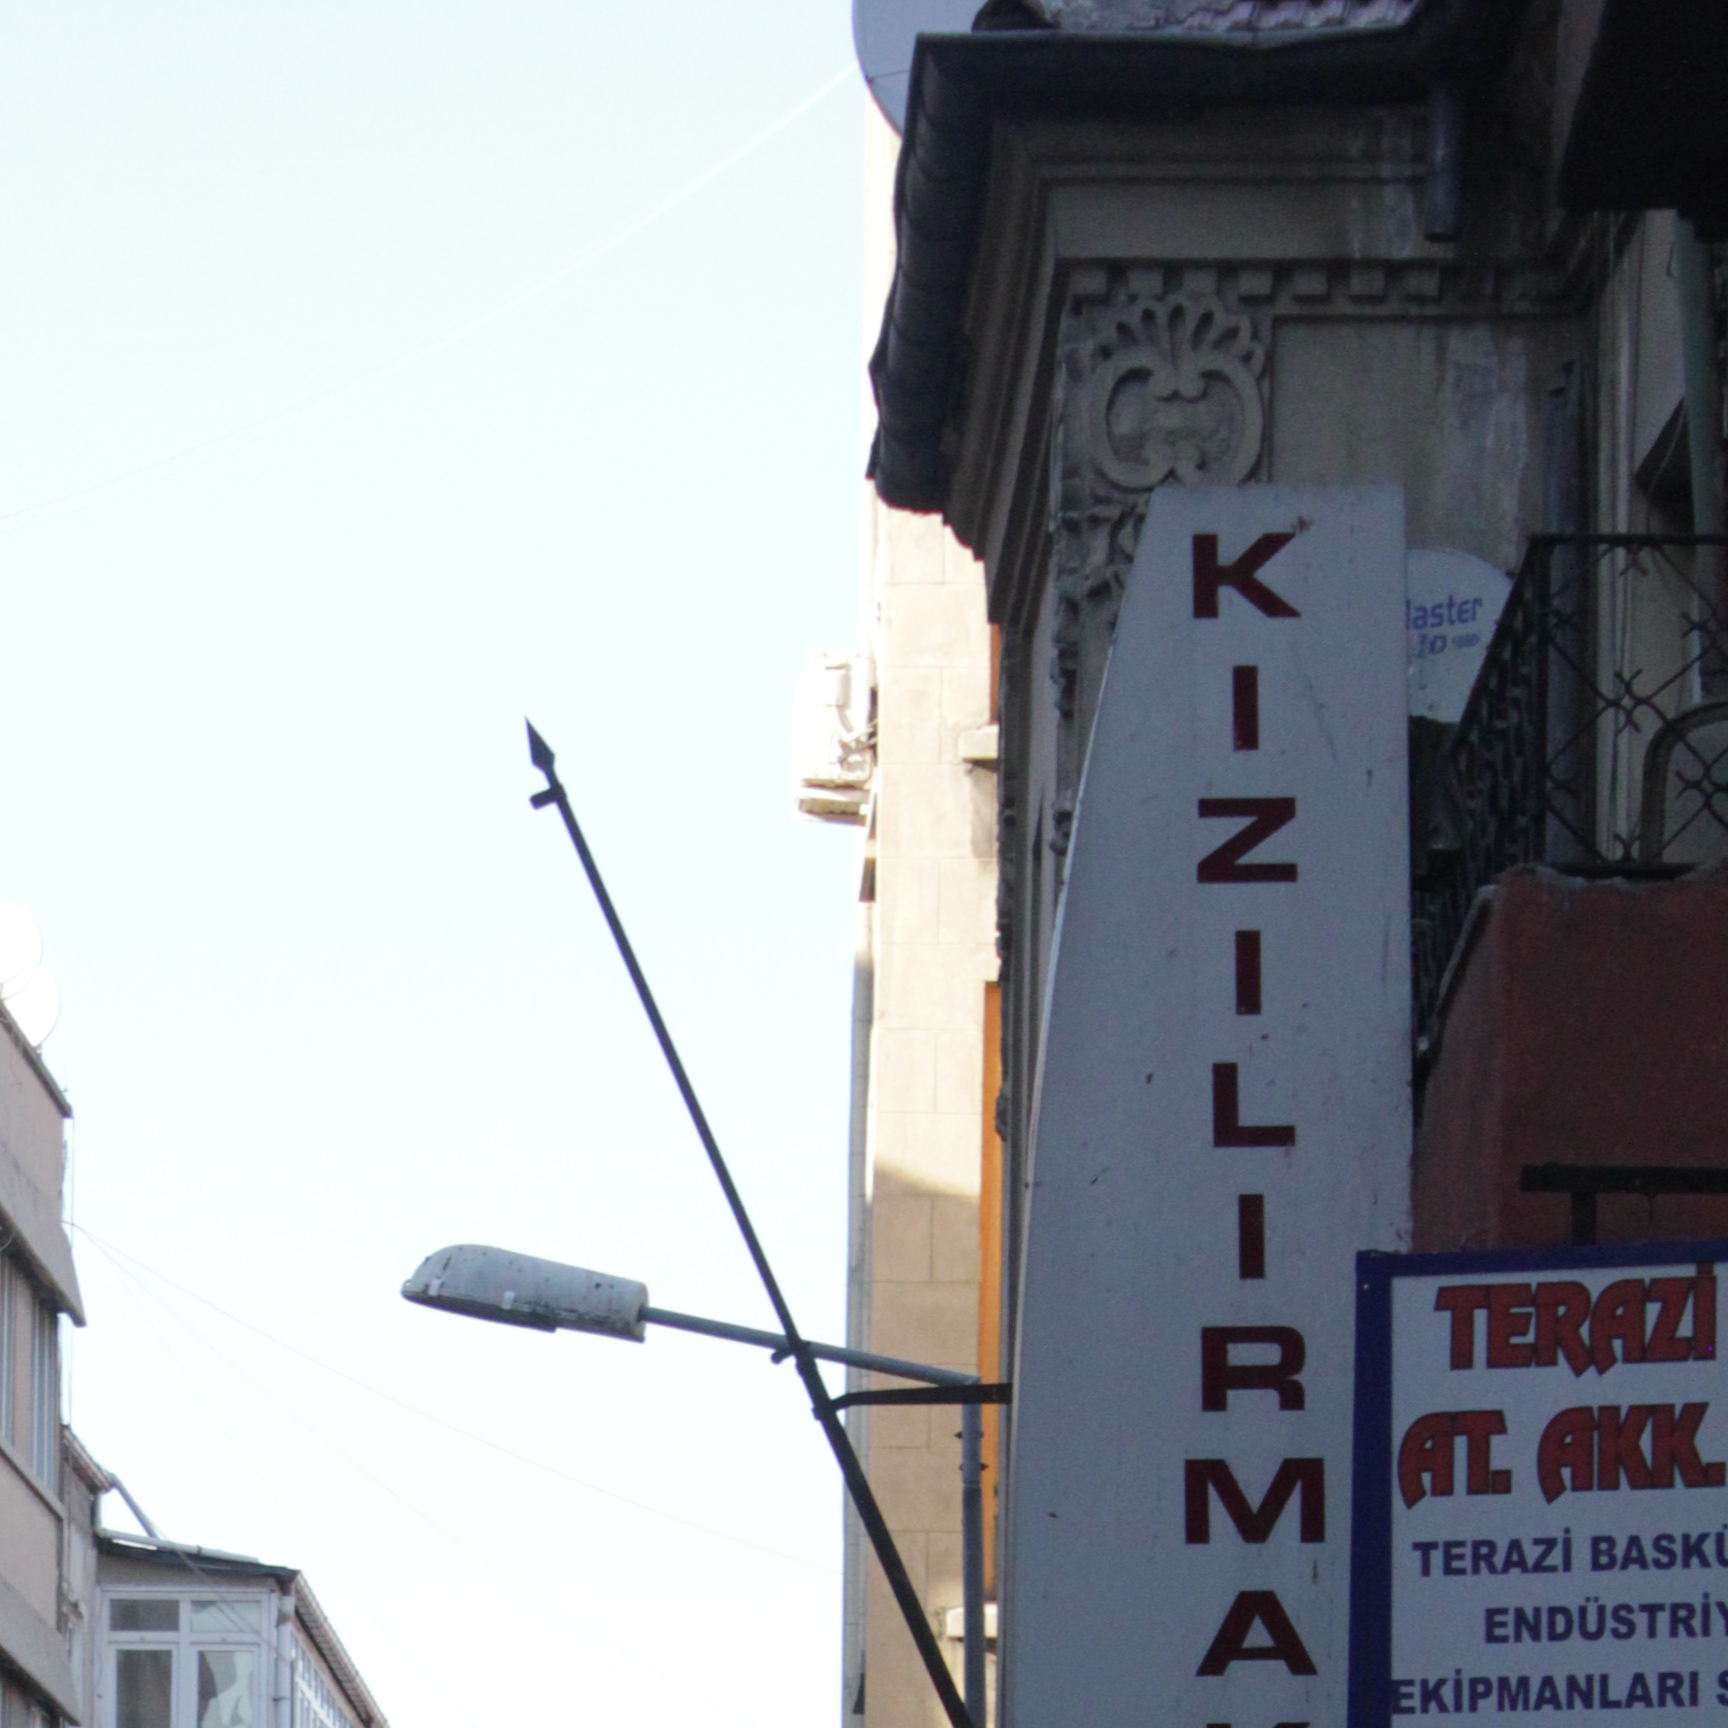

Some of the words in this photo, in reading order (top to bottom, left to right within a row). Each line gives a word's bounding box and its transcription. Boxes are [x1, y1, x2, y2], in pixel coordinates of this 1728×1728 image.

[1434, 1261, 1717, 1377] TERAZİ
[1398, 1409, 1512, 1511] AT.
[1537, 1402, 1727, 1505] AKK.
[1412, 1527, 1572, 1579] TERAZİ
[1390, 1667, 1700, 1717] EKİPMANLARI
